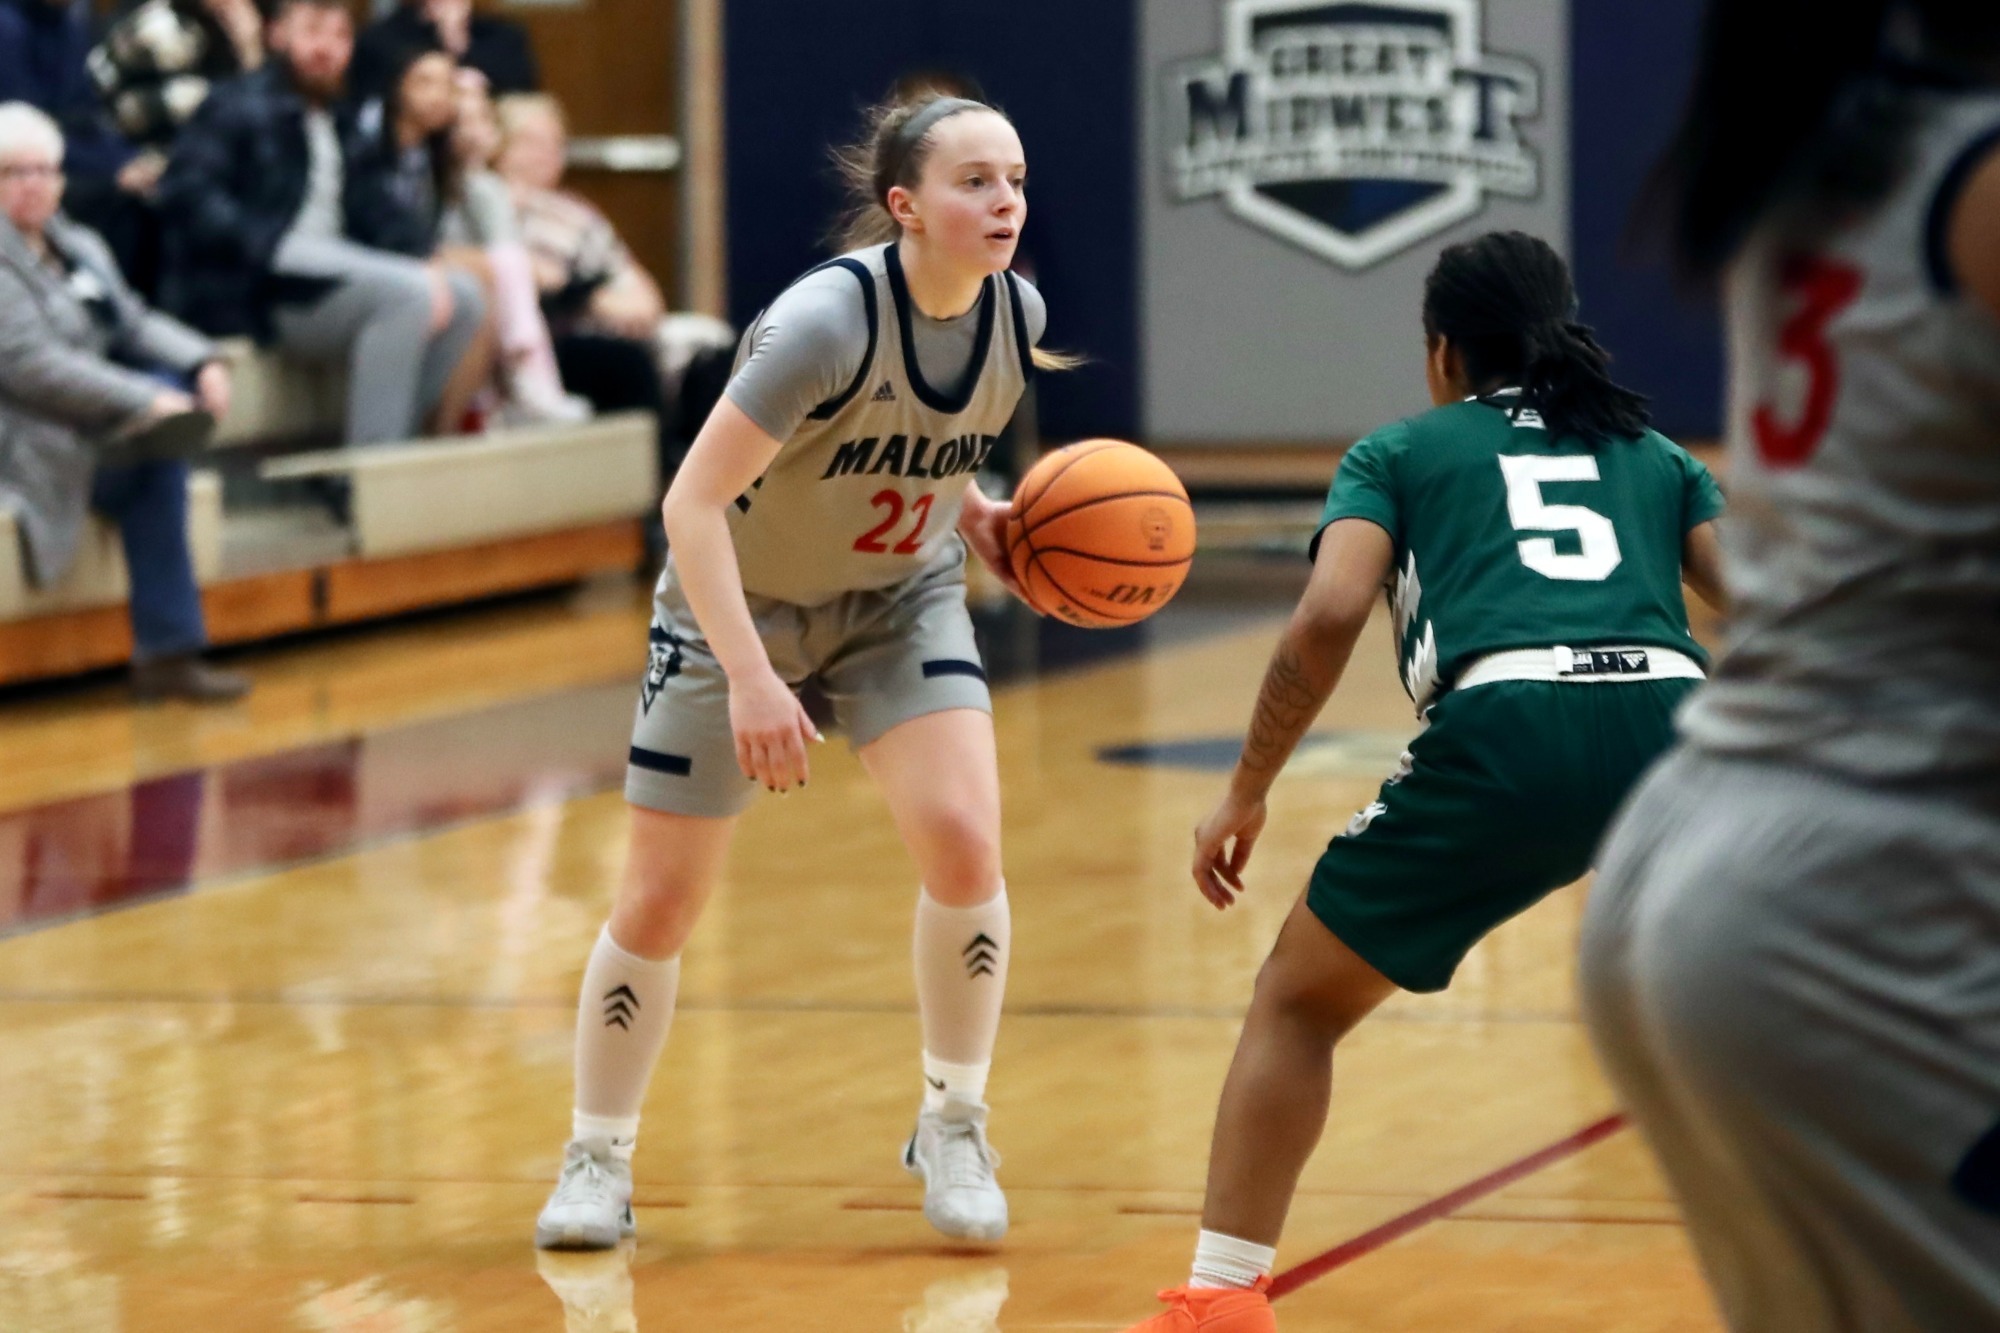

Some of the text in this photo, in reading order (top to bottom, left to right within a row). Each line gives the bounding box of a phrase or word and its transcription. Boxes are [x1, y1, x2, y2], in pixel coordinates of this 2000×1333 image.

[1186, 68, 1524, 150] MIDWEST
[1752, 256, 1864, 474] 3
[1498, 453, 1622, 581] 5
